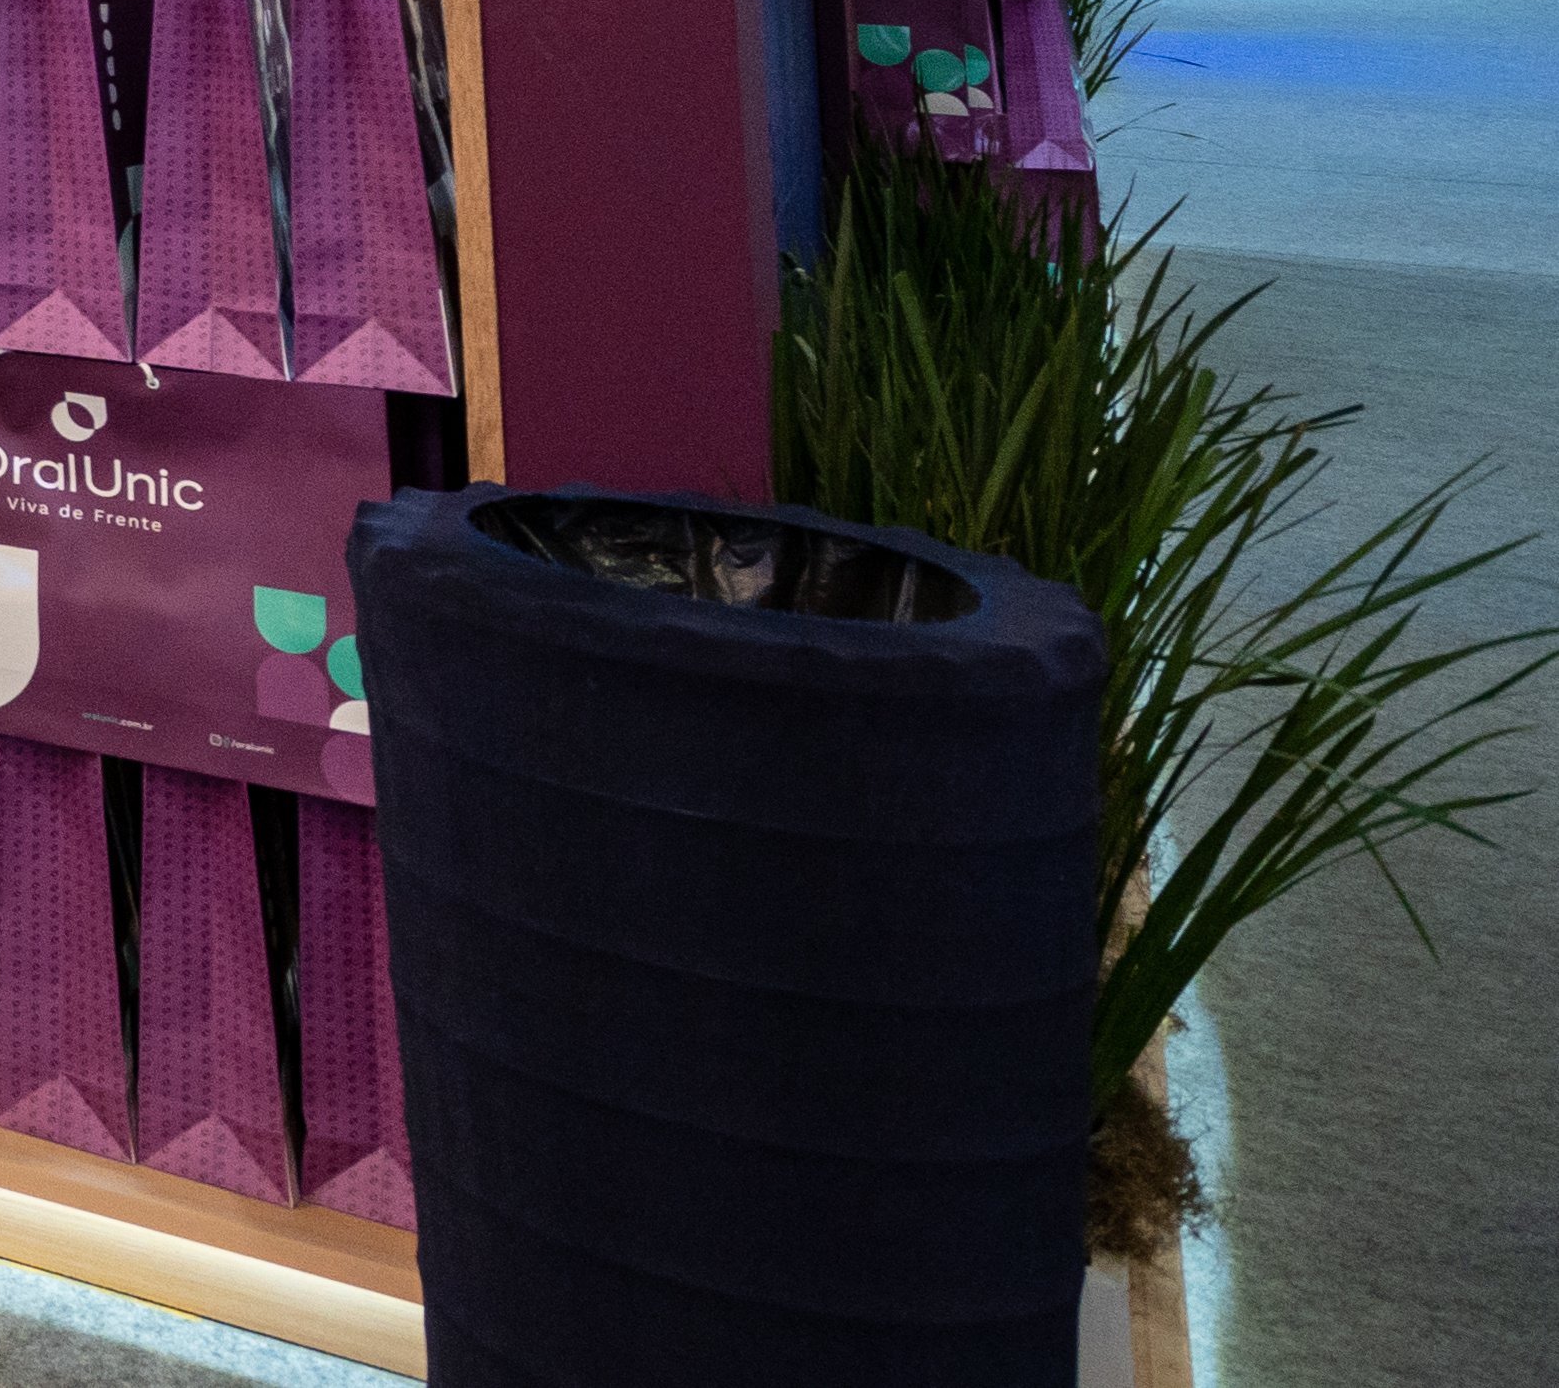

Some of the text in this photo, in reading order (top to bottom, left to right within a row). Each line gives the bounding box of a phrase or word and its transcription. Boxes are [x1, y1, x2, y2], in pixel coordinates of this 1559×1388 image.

[6, 497, 163, 533] Viva de Frente
